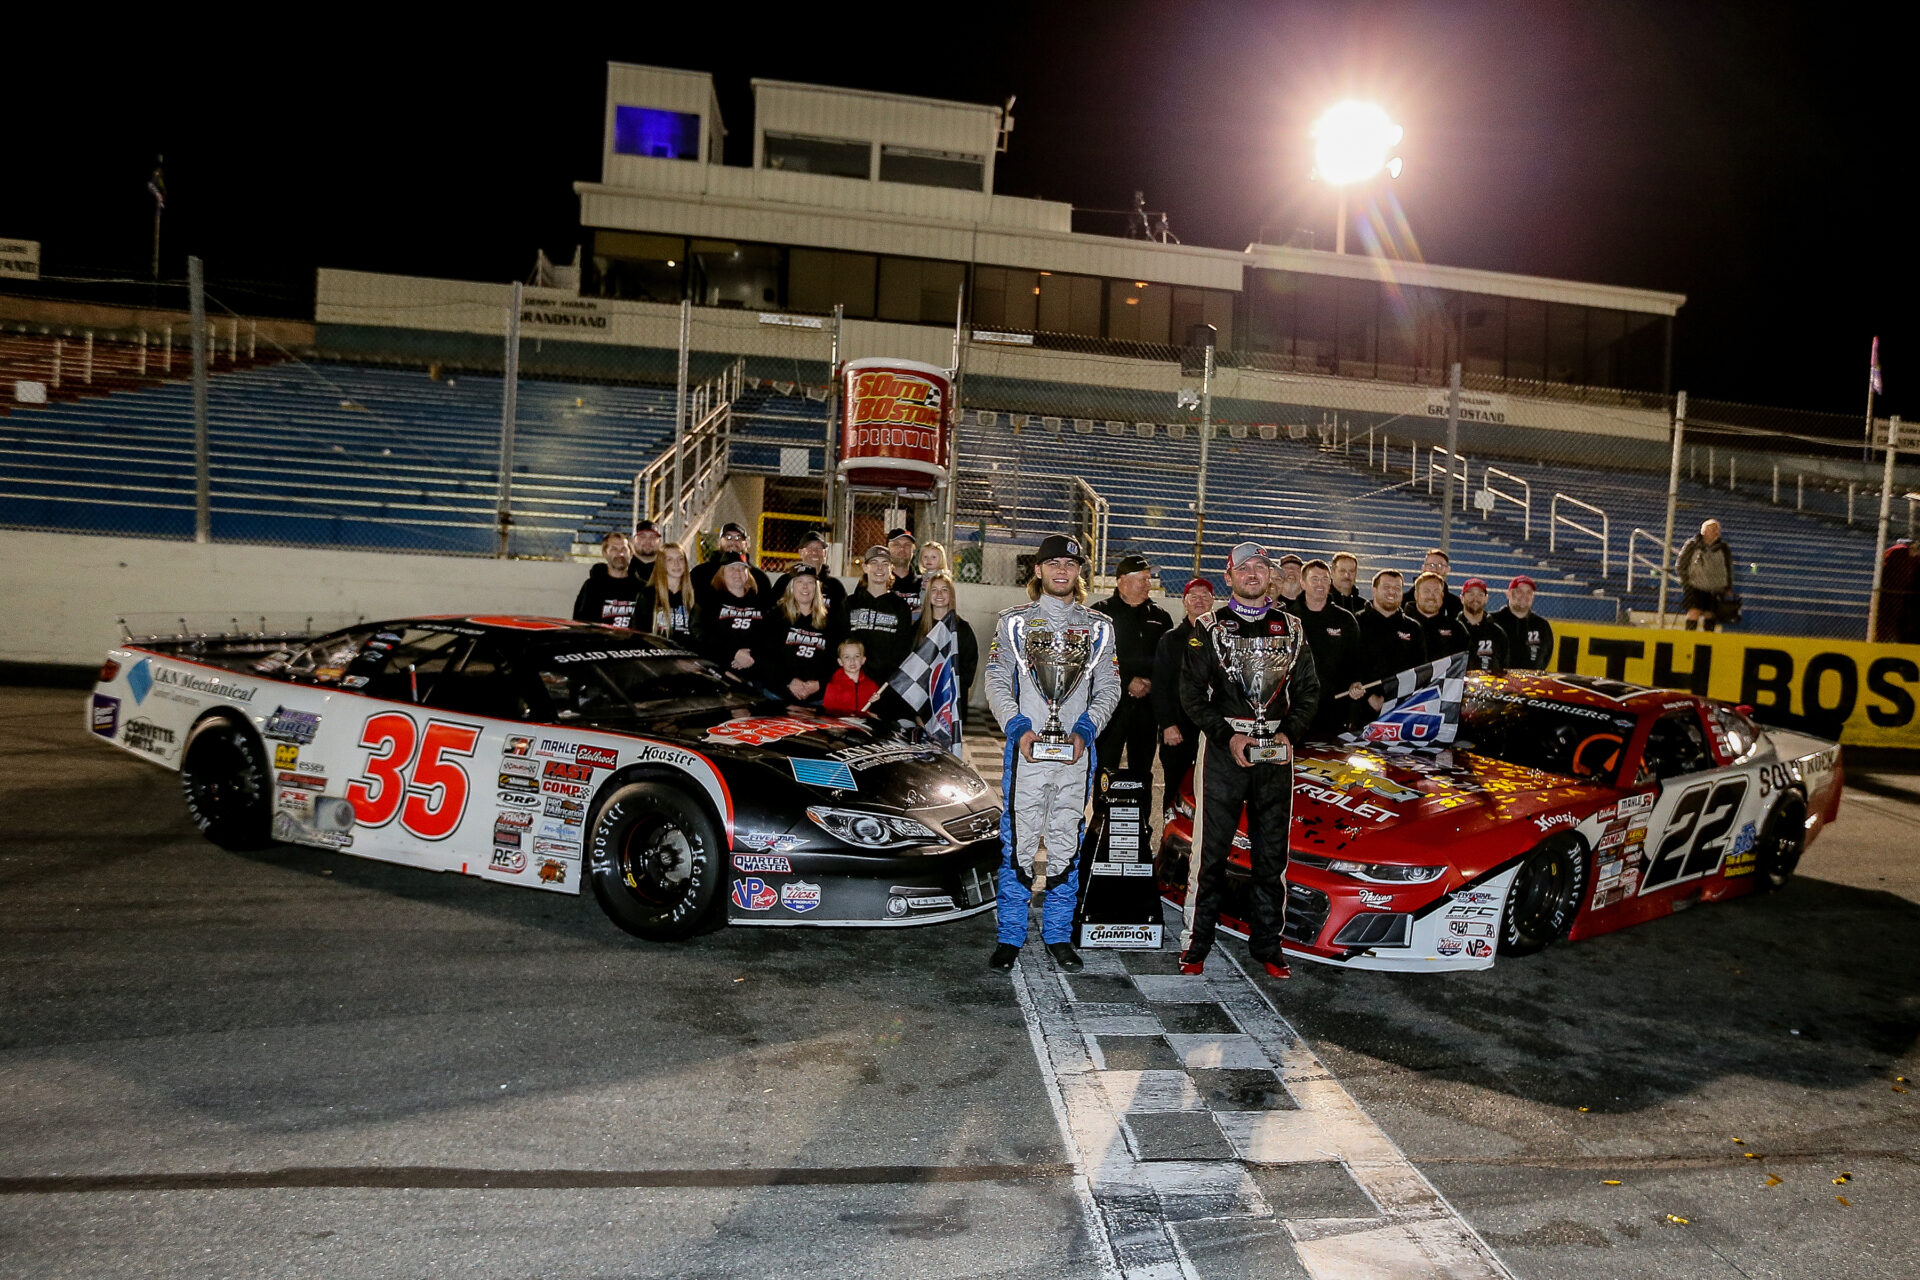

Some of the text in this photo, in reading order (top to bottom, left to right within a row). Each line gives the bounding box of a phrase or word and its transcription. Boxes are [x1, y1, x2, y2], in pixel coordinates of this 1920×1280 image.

[520, 311, 607, 329] RANDSTAND
[856, 373, 931, 402] SOUTH
[855, 397, 940, 428] BOSTON
[1427, 404, 1505, 422] GRADSTAND
[849, 428, 939, 450] SPEEDWAY
[1236, 604, 1261, 615] Hoosier
[613, 617, 631, 628] 35
[732, 618, 752, 630] 35
[1528, 630, 1540, 641] 22
[796, 645, 816, 658] 35
[1478, 640, 1493, 650] 22
[554, 651, 608, 664] SOLID
[607, 649, 649, 659] ROCK
[1527, 699, 1611, 721] CARRIERS
[541, 739, 578, 755] MAHLE
[637, 745, 697, 766] Hoosier
[577, 748, 616, 766] Edelbrock
[346, 709, 483, 841] 35
[544, 760, 592, 781] FAST
[543, 780, 581, 796] COMP
[1534, 811, 1581, 832] Hoosier
[591, 802, 625, 876] Hoosier
[1637, 774, 1751, 897] 22
[735, 856, 787, 866] QUARTER
[744, 863, 789, 871] MASTER
[733, 877, 765, 910] VP
[787, 891, 818, 899] LUCAS
[1448, 905, 1499, 917] PFC
[1090, 931, 1153, 941] CHAMPION
